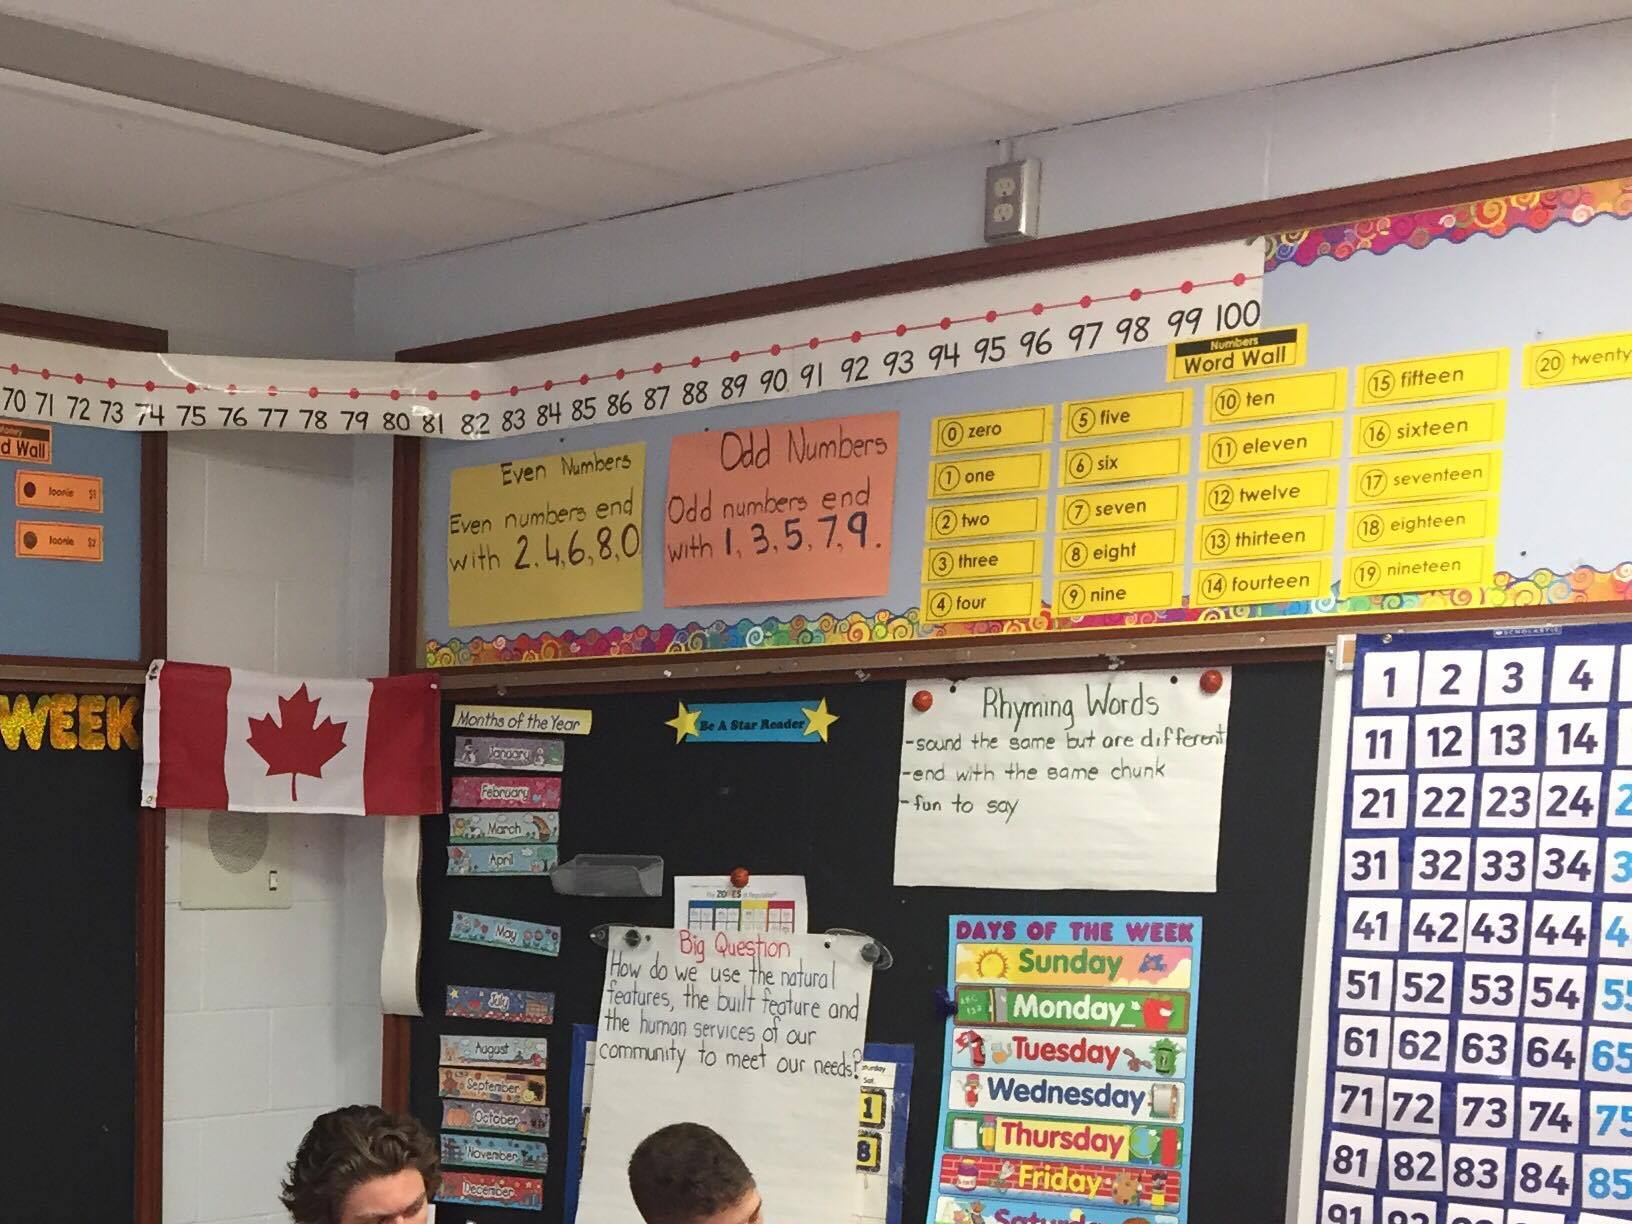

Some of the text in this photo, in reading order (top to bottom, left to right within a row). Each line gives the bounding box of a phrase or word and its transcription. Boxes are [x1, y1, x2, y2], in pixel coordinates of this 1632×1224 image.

[974, 300, 1261, 363] 95 97 100
[1210, 336, 1258, 352] Numbers
[1184, 346, 1286, 375] Word Wall
[1541, 348, 1630, 371] 20 twenty
[1373, 367, 1464, 391] 15 fifteen
[1246, 391, 1275, 408] ten
[1100, 410, 1130, 425] five
[968, 423, 1001, 439] zero
[17, 441, 45, 459] Wall
[721, 425, 887, 471] Odd Numbers
[1243, 435, 1307, 456] eleven
[501, 453, 631, 486] Even Numbers
[1394, 466, 1483, 487] seventeen
[668, 476, 870, 523] Odd numbers end
[1240, 484, 1300, 503] twelve
[450, 488, 633, 535] Even numbers end
[1095, 501, 1146, 517] seven
[1093, 542, 1136, 561] eight
[1387, 558, 1461, 577] nineteen
[1232, 572, 1310, 592] fourteen
[1568, 659, 1593, 690] 4
[983, 682, 1159, 730] Rhyming Words
[457, 712, 580, 731] Months of the Year
[700, 716, 805, 733] Be A Star Reader
[971, 724, 1225, 752] the same but are different
[1427, 726, 1463, 757] 12
[956, 757, 1166, 782] with the same chunk
[481, 785, 529, 800] February
[1360, 784, 1593, 819] 21 24
[488, 822, 521, 834] March
[496, 924, 517, 941] May
[956, 921, 1194, 942] DAYS OF THE WEEK
[680, 929, 790, 963] Big Question
[610, 951, 835, 989] How we use the natural
[1019, 948, 1123, 979] Sunday
[1013, 994, 1125, 1028] Monday
[640, 1010, 755, 1041] human services
[475, 1042, 508, 1057] August
[599, 1040, 767, 1073] community meet
[1012, 1036, 1120, 1071] Tuesday
[988, 1077, 1146, 1115] Wednesday
[1001, 1122, 1125, 1159] Thursday
[463, 1181, 514, 1197] December
[1018, 1166, 1103, 1201] Friday
